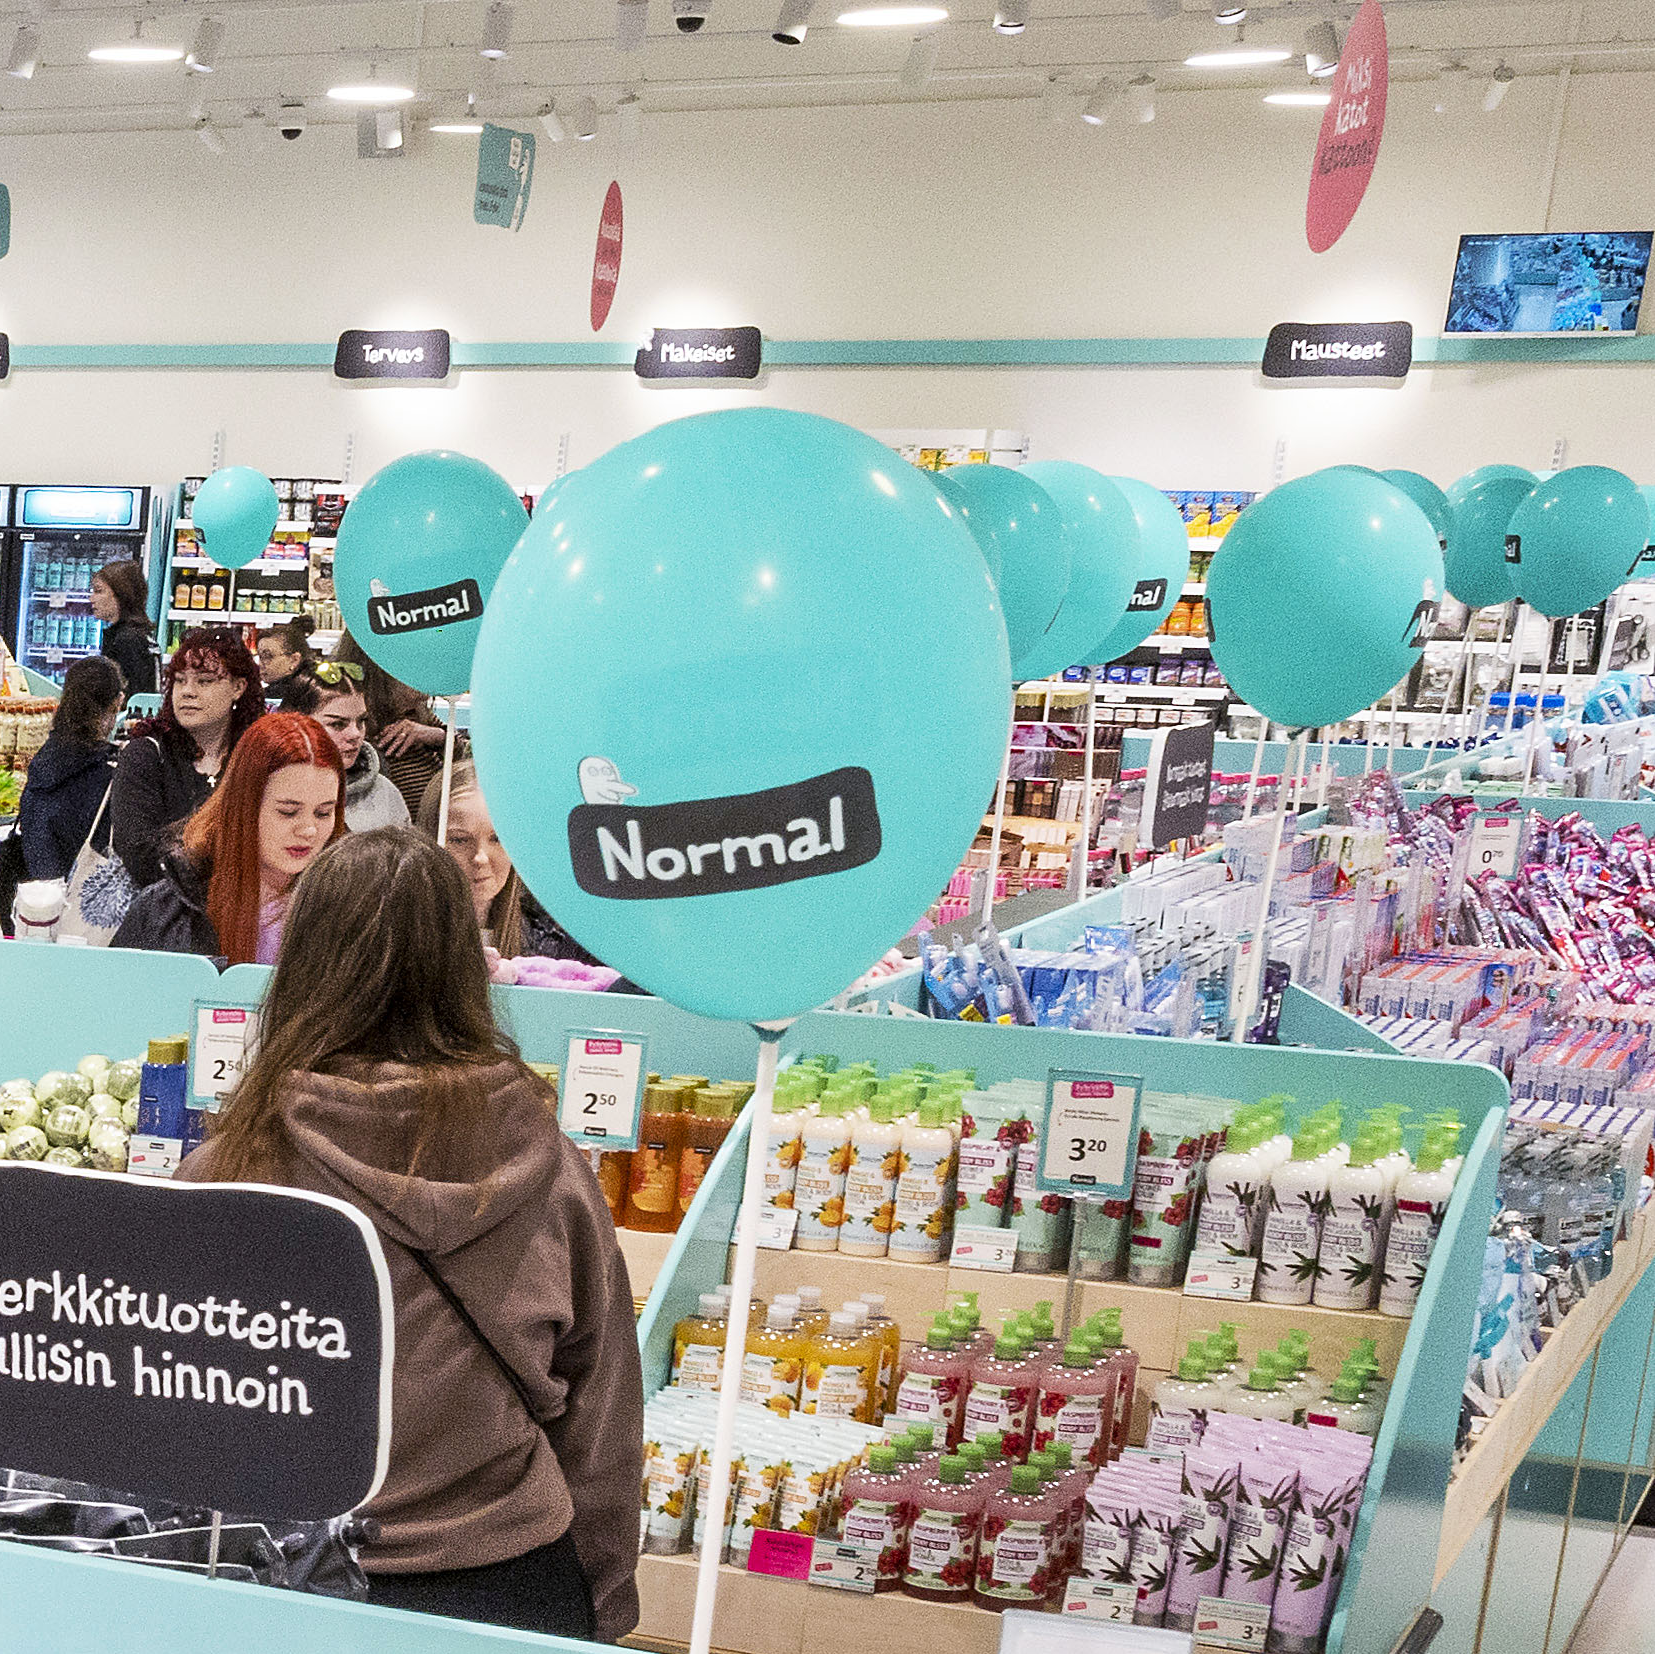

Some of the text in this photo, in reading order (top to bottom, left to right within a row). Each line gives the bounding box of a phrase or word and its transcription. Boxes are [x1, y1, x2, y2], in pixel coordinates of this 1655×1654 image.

[660, 342, 736, 364] Makeiset
[1289, 339, 1386, 361] Mausteet
[376, 589, 470, 628] Normal
[596, 795, 846, 881] Normal
[132, 1352, 313, 1416] hinnoin
